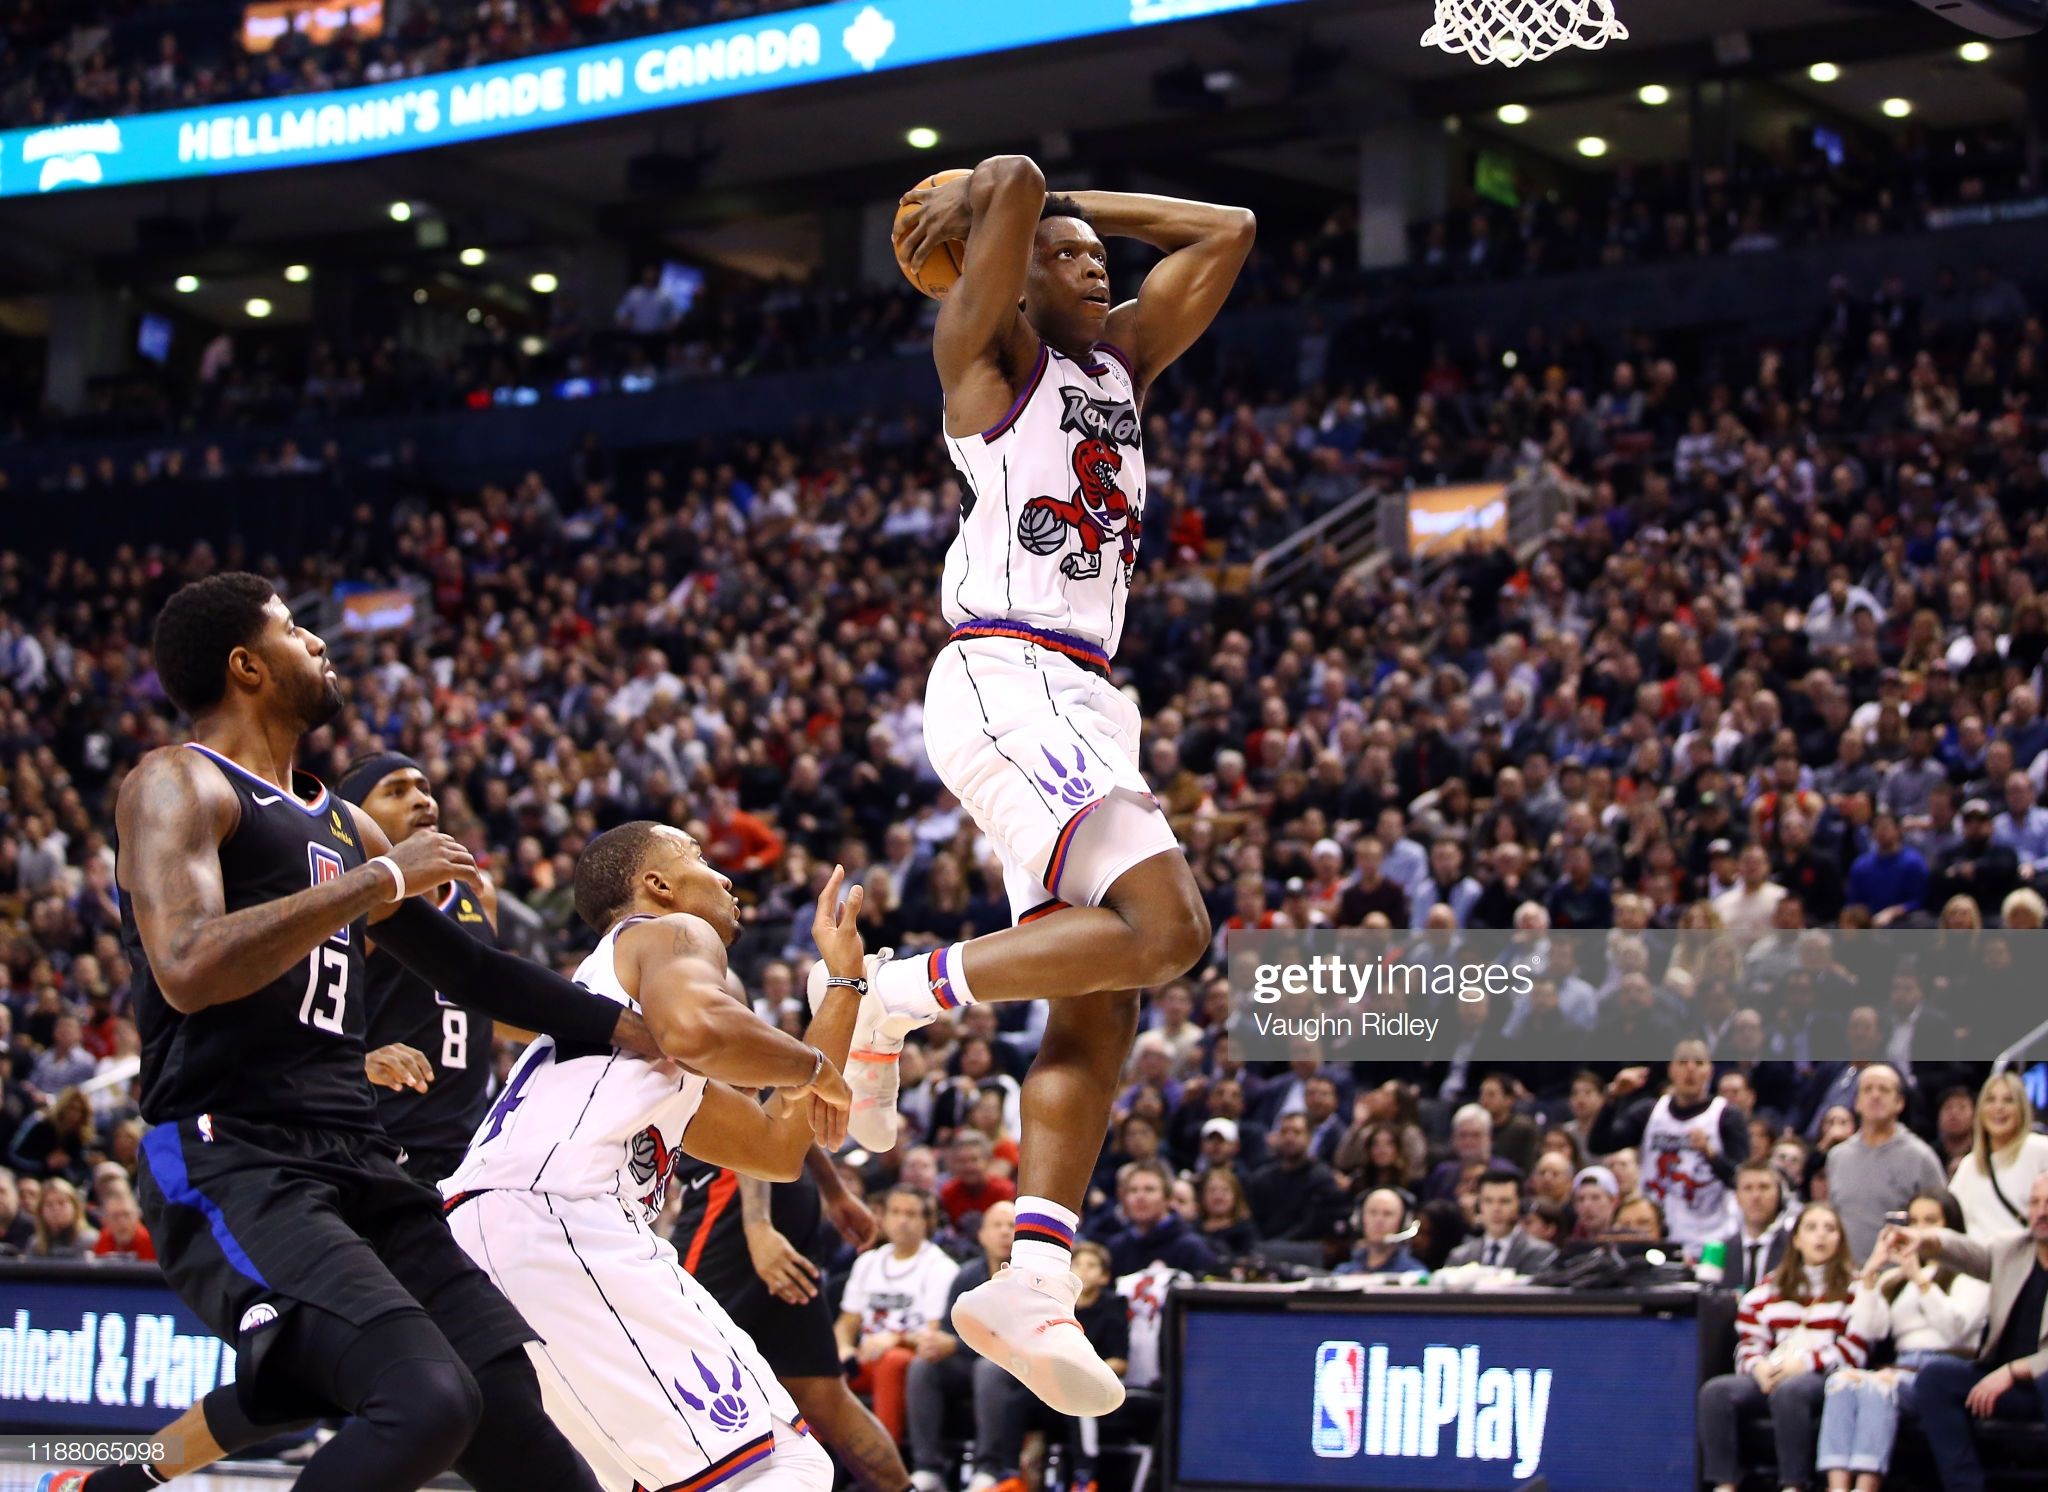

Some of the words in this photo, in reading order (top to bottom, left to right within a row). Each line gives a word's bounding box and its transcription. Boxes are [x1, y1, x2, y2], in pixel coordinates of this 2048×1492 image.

[178, 89, 440, 163] HELLMANN'S
[449, 66, 566, 127] MADE
[577, 57, 624, 105] IN
[634, 22, 821, 95] CANADA
[299, 945, 350, 1035] 13
[441, 1009, 468, 1069] 8
[95, 1312, 128, 1407] &
[1364, 1343, 1554, 1480] InPlay
